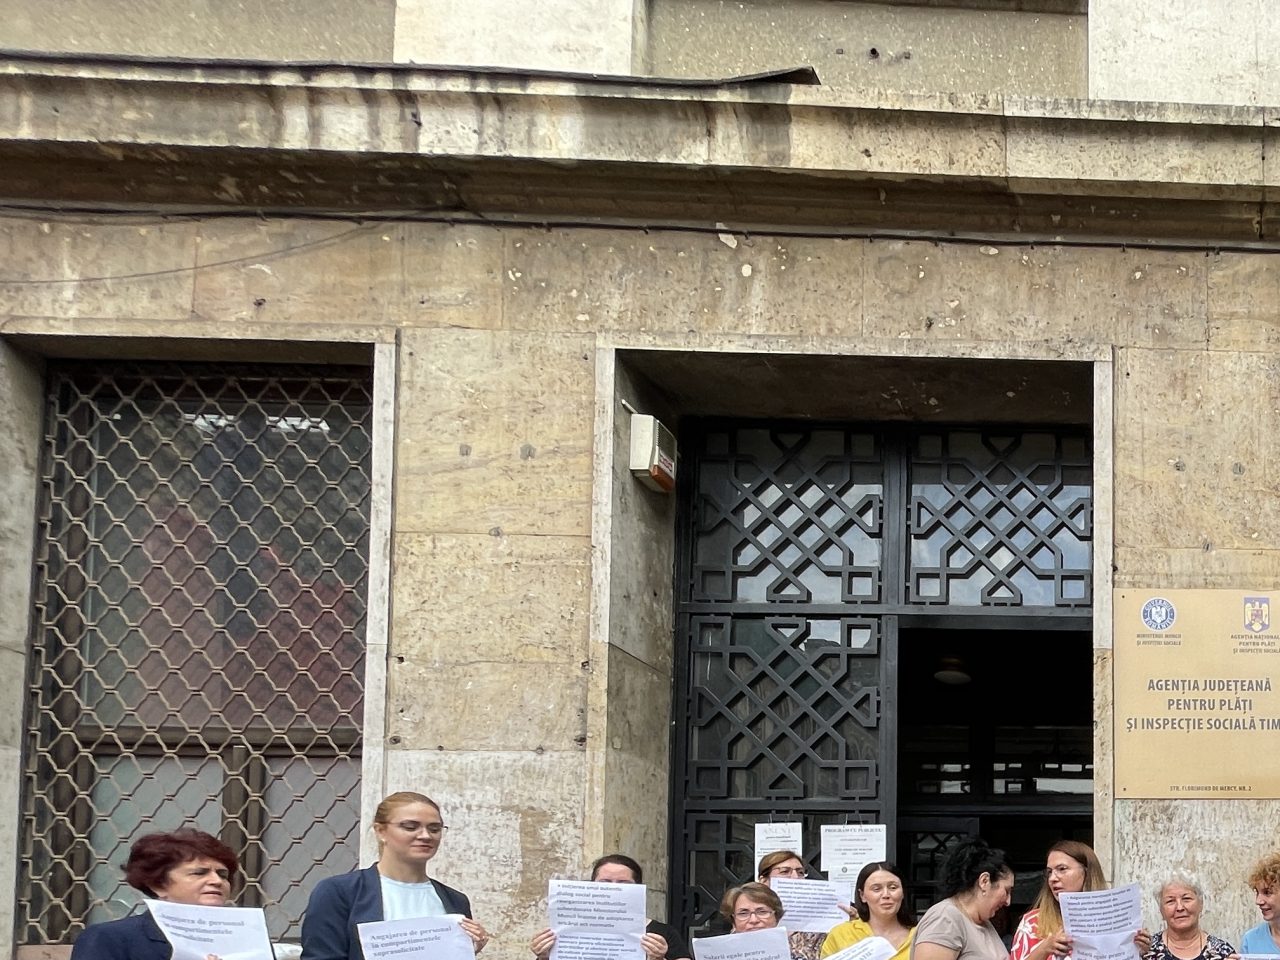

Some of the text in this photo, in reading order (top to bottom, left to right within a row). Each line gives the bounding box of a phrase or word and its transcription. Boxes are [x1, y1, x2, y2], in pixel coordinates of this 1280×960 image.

[1148, 678, 1271, 694] AGENȚIA JUDEȚEANĂ
[1168, 699, 1252, 714] PENTRU PLĂȚI
[1127, 718, 1137, 733] ȘI
[1142, 718, 1203, 733] INSPECȚIE
[1207, 717, 1256, 730] SOCIALĂ
